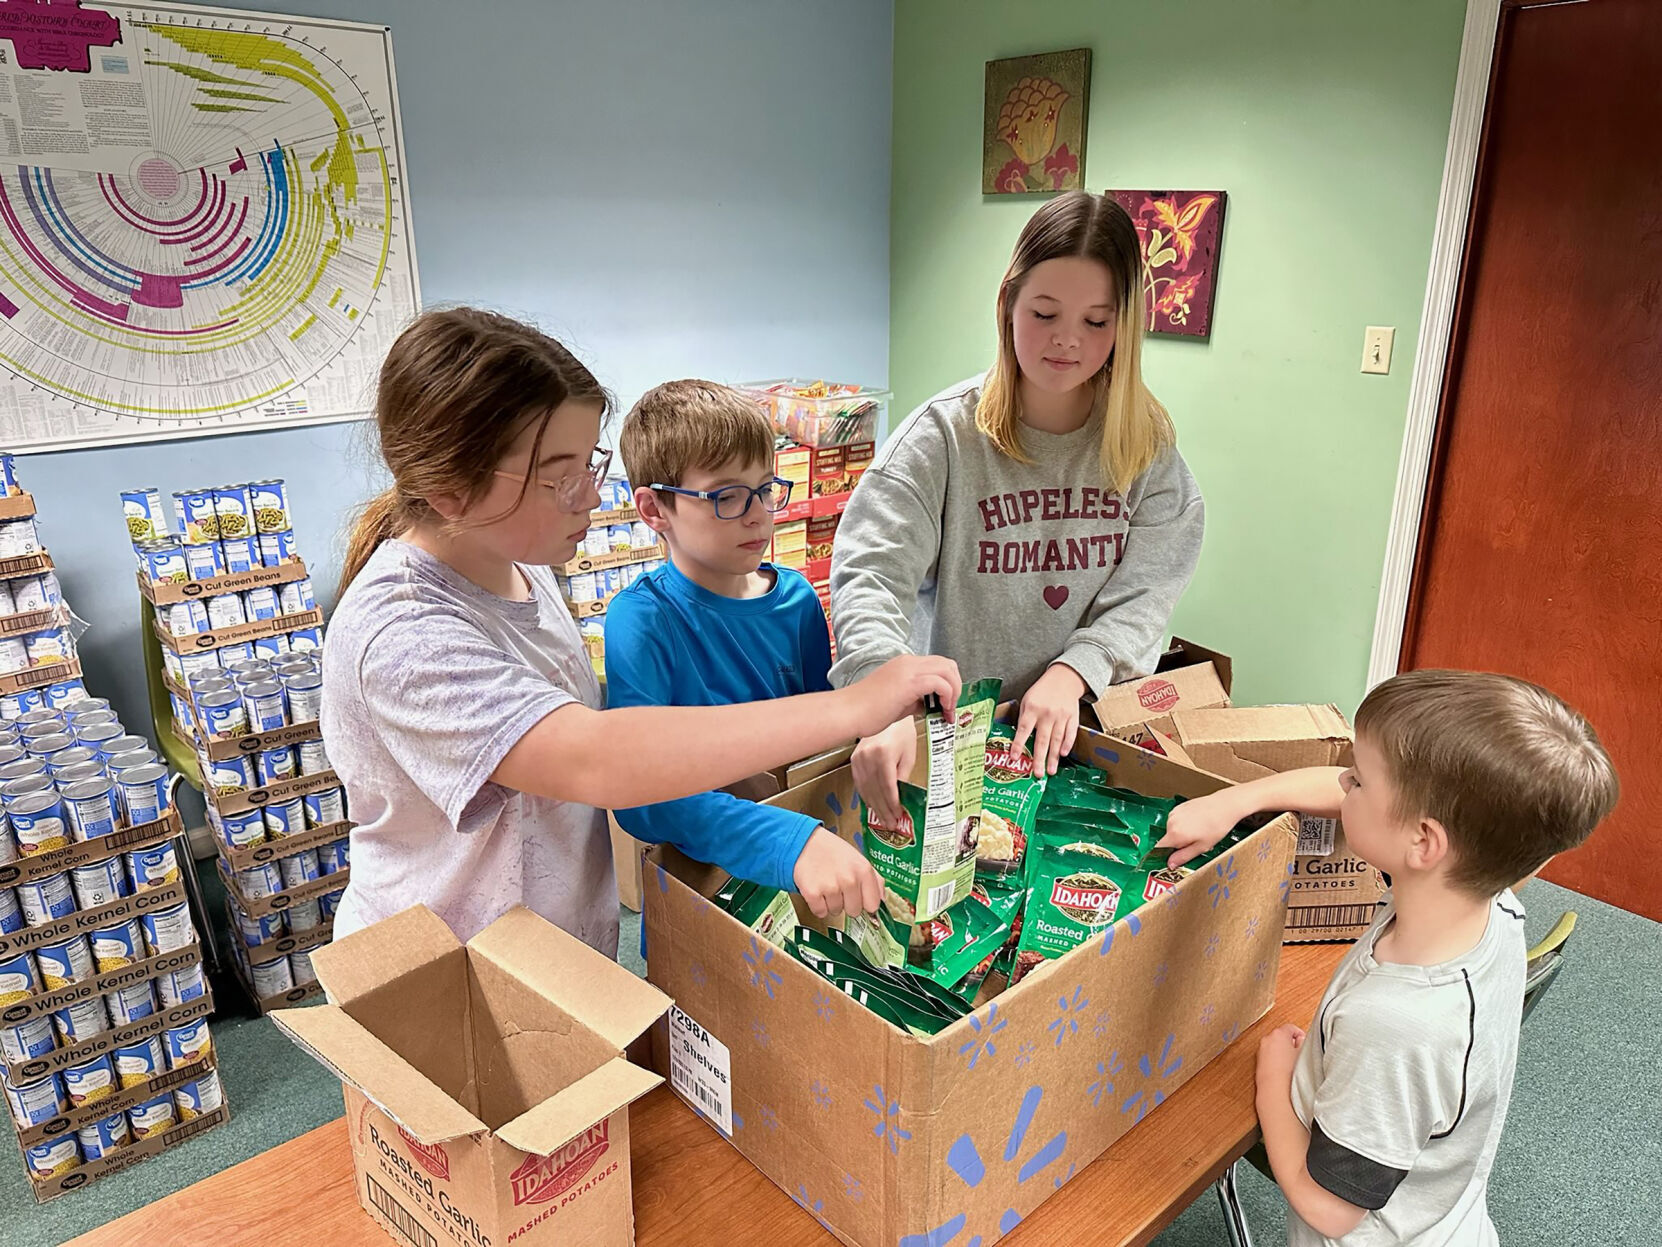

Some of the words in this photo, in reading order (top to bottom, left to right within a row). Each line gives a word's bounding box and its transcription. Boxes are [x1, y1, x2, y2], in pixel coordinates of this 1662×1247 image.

[977, 487, 1130, 532] HOPELES
[205, 581, 222, 591] Cut
[224, 577, 251, 588] Green
[254, 572, 281, 583] Beans
[264, 735, 280, 743] Cut
[285, 728, 314, 740] Green
[272, 787, 289, 796] Cut
[292, 780, 321, 792] Green
[28, 861, 62, 876] Kernel
[64, 852, 90, 864] Corn
[40, 849, 74, 862] Whole
[895, 857, 920, 876] Garlic
[1306, 858, 1367, 875] Garlic
[12, 924, 70, 947] Whole
[76, 902, 131, 928] Kernel
[136, 891, 177, 909] Corn
[1036, 919, 1084, 942] Roasted
[298, 934, 315, 944] Cut
[317, 928, 333, 937] Gre
[34, 987, 91, 1011] Whole
[97, 965, 150, 991] Kernel
[155, 952, 196, 971] Corn
[53, 1041, 107, 1066] Whole
[113, 1016, 164, 1041] Kernel
[169, 1002, 208, 1021] Corn
[683, 1039, 727, 1084] Shelves
[77, 1107, 109, 1124] Kernel
[110, 1097, 135, 1111] Corn
[88, 1095, 120, 1111] Whole
[94, 1162, 126, 1179] Kernel
[126, 1152, 150, 1165] Corn
[104, 1149, 135, 1166] Whole
[516, 1121, 606, 1203] IDAHOAN
[368, 1123, 435, 1200] Roasted
[438, 1190, 492, 1247] Garlic
[380, 1159, 422, 1203] MASHED
[507, 1205, 558, 1244] MASHED
[561, 1161, 619, 1207] POTATOES
